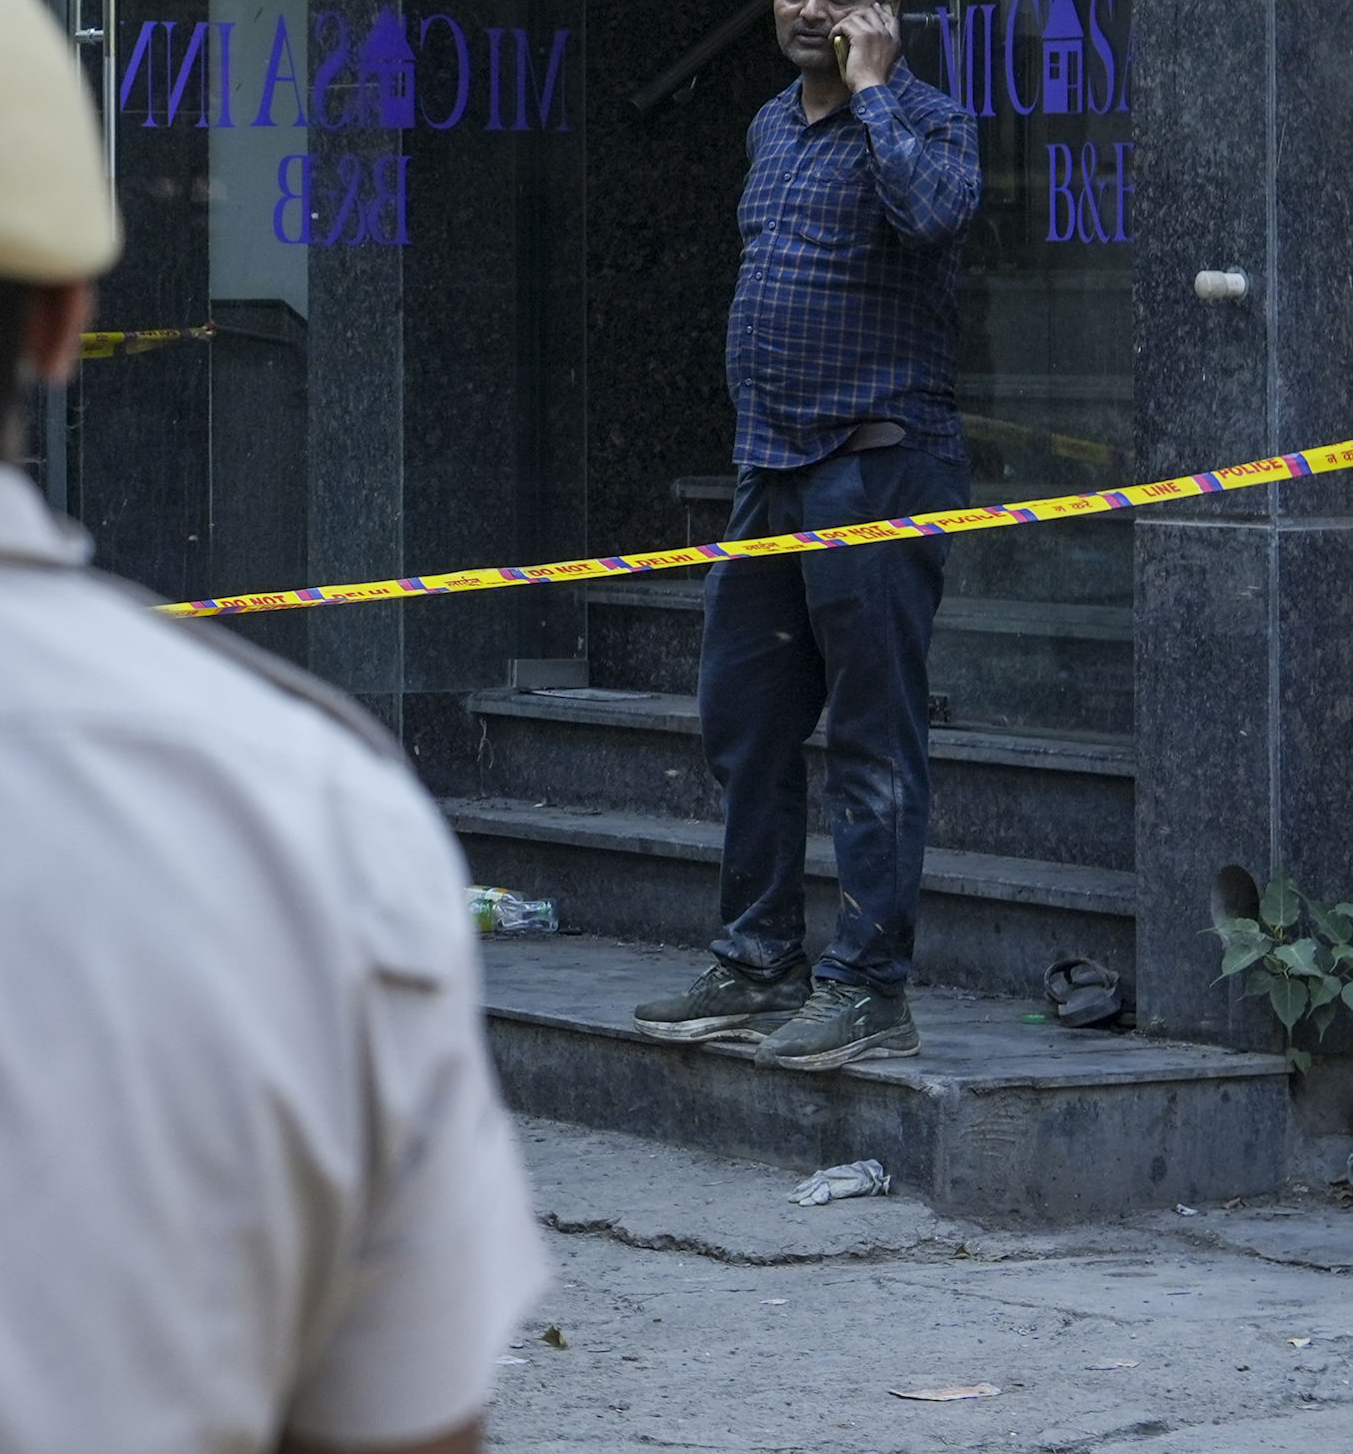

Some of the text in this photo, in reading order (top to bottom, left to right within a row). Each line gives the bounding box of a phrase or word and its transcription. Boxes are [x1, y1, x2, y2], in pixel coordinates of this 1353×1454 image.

[1216, 457, 1284, 479] POLICE
[1142, 481, 1182, 497] LINE
[821, 529, 848, 540] DO
[634, 553, 695, 567] DELHI
[527, 563, 592, 578] DO NOT
